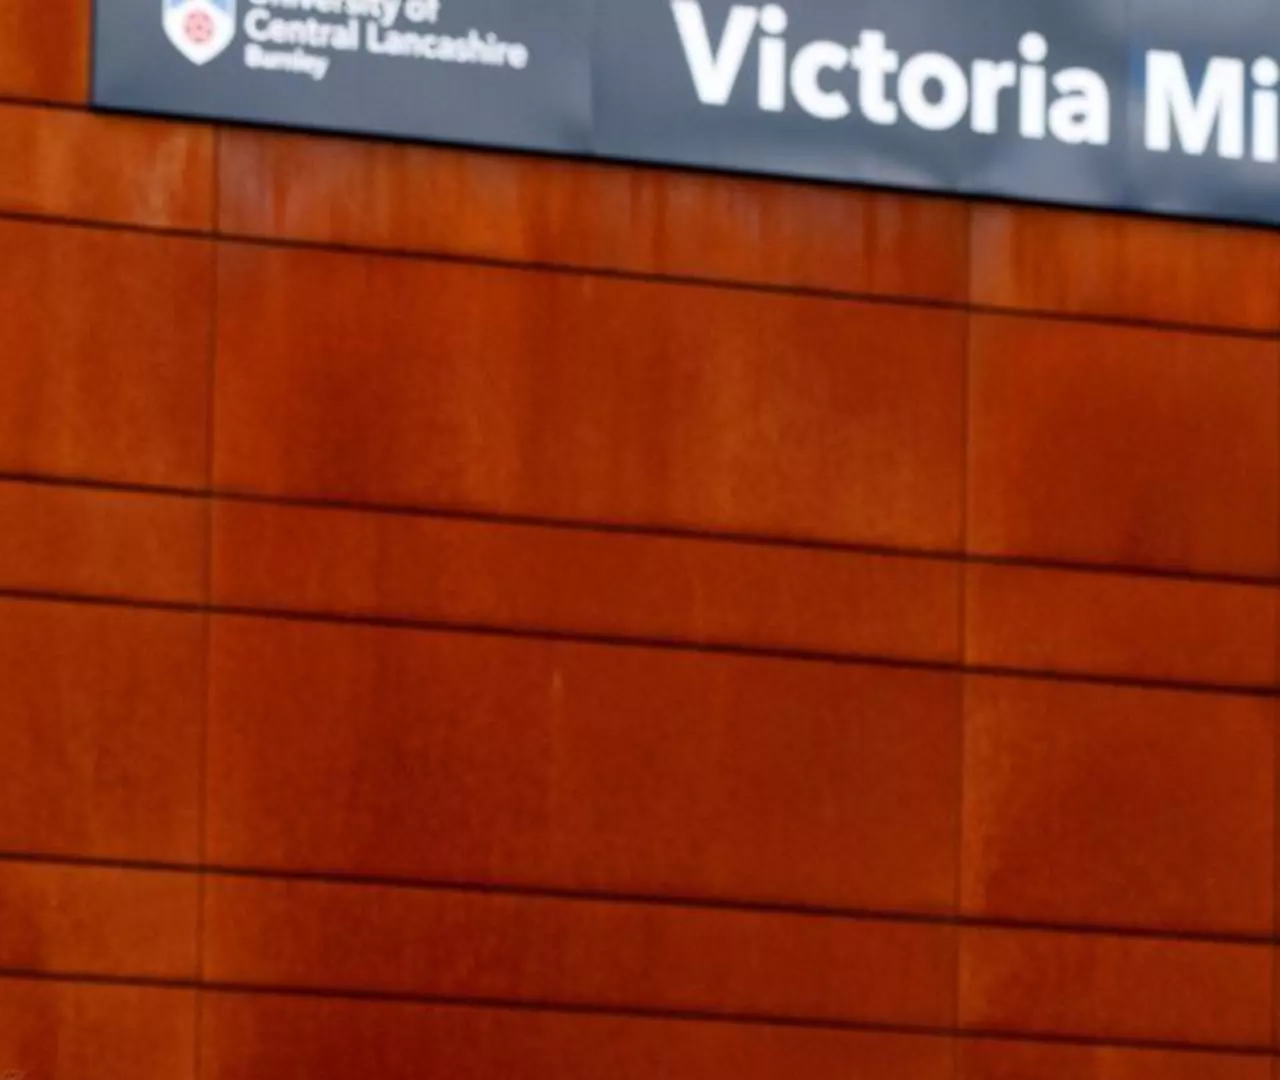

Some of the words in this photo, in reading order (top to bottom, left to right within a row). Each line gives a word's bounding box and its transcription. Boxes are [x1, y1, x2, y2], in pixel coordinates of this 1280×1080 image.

[243, 7, 359, 50] Central
[366, 20, 529, 69] Lancashire
[670, 0, 1111, 146] Victoria
